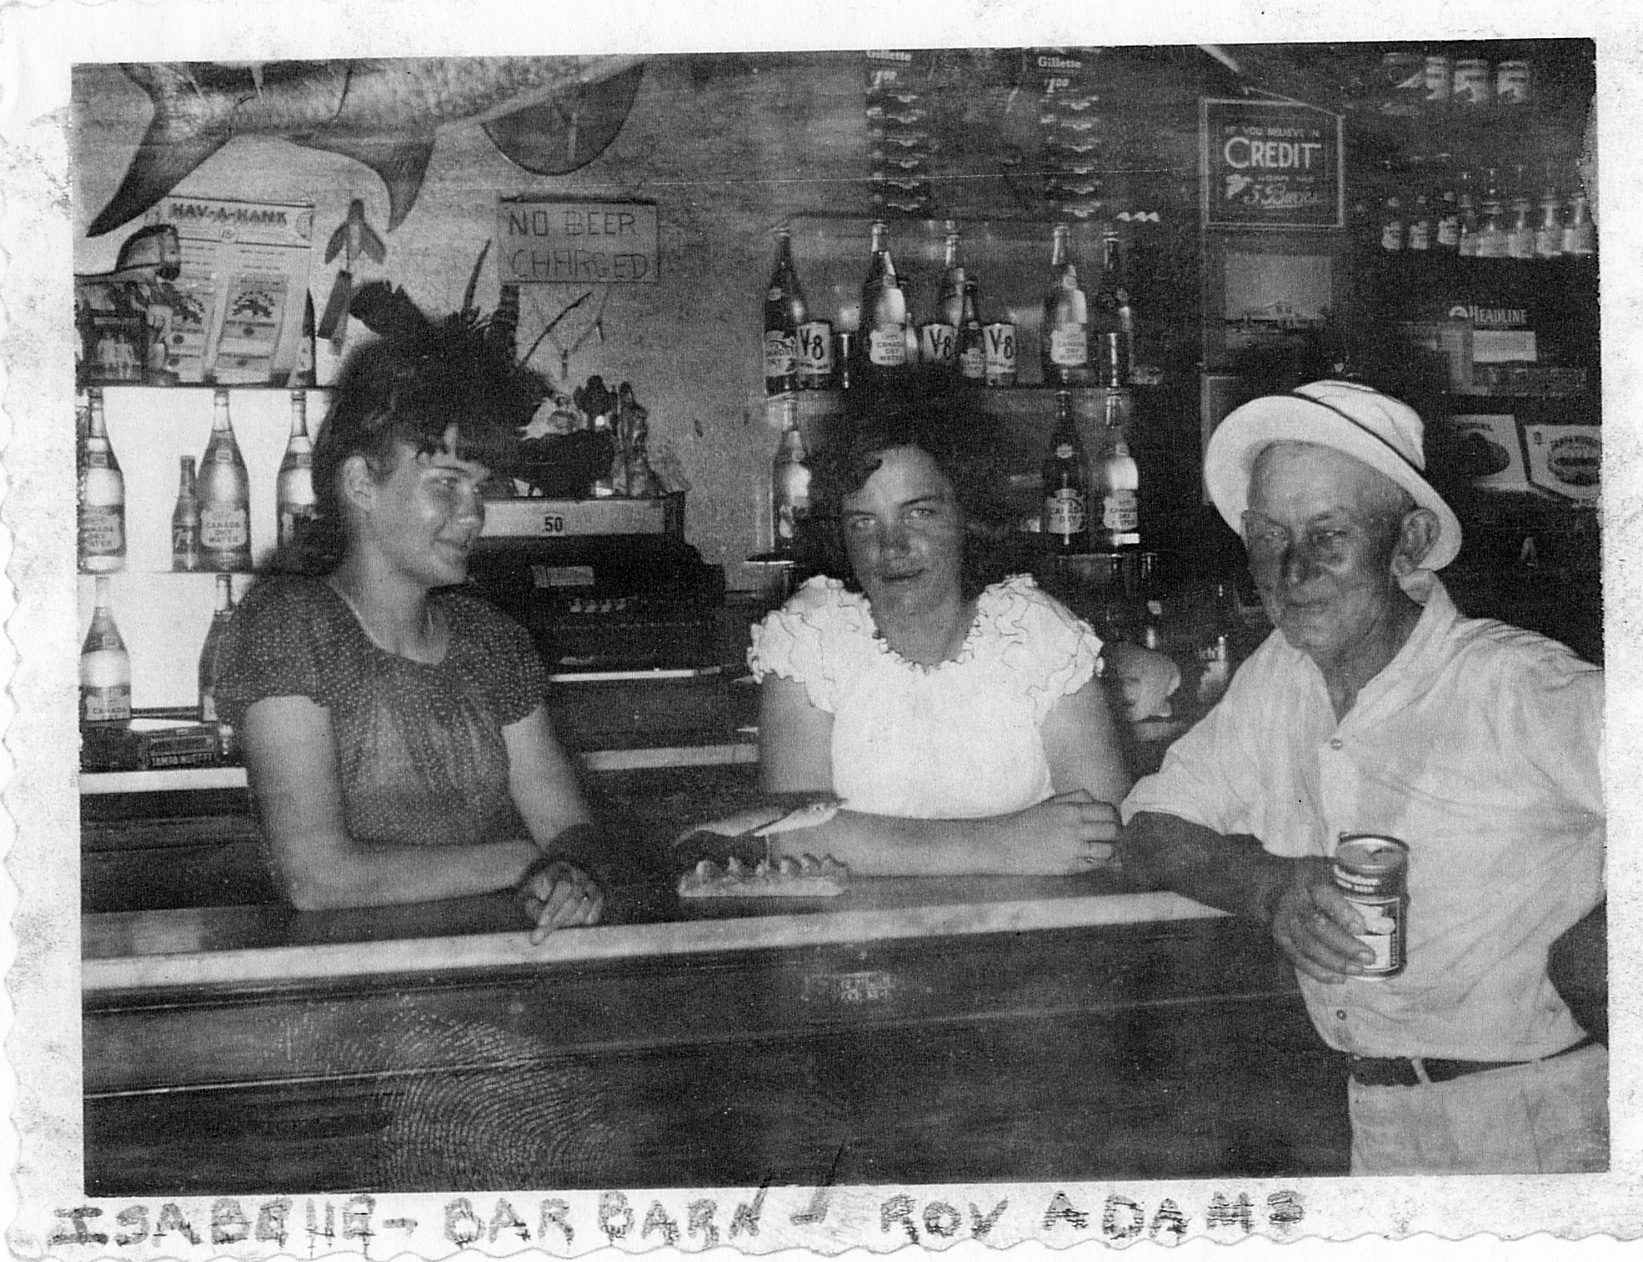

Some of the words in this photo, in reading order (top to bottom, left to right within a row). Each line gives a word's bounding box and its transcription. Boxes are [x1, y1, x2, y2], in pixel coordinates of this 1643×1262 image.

[1038, 56, 1081, 68] Gillette
[1242, 126, 1263, 136] YOU
[1224, 136, 1322, 169] CREDIT
[509, 210, 548, 237] NO
[563, 211, 636, 237] BEER
[512, 249, 648, 280] CHARGED
[207, 521, 240, 529] CANADA
[880, 1194, 1009, 1244] ROY
[1043, 1190, 1304, 1243] ADAMS
